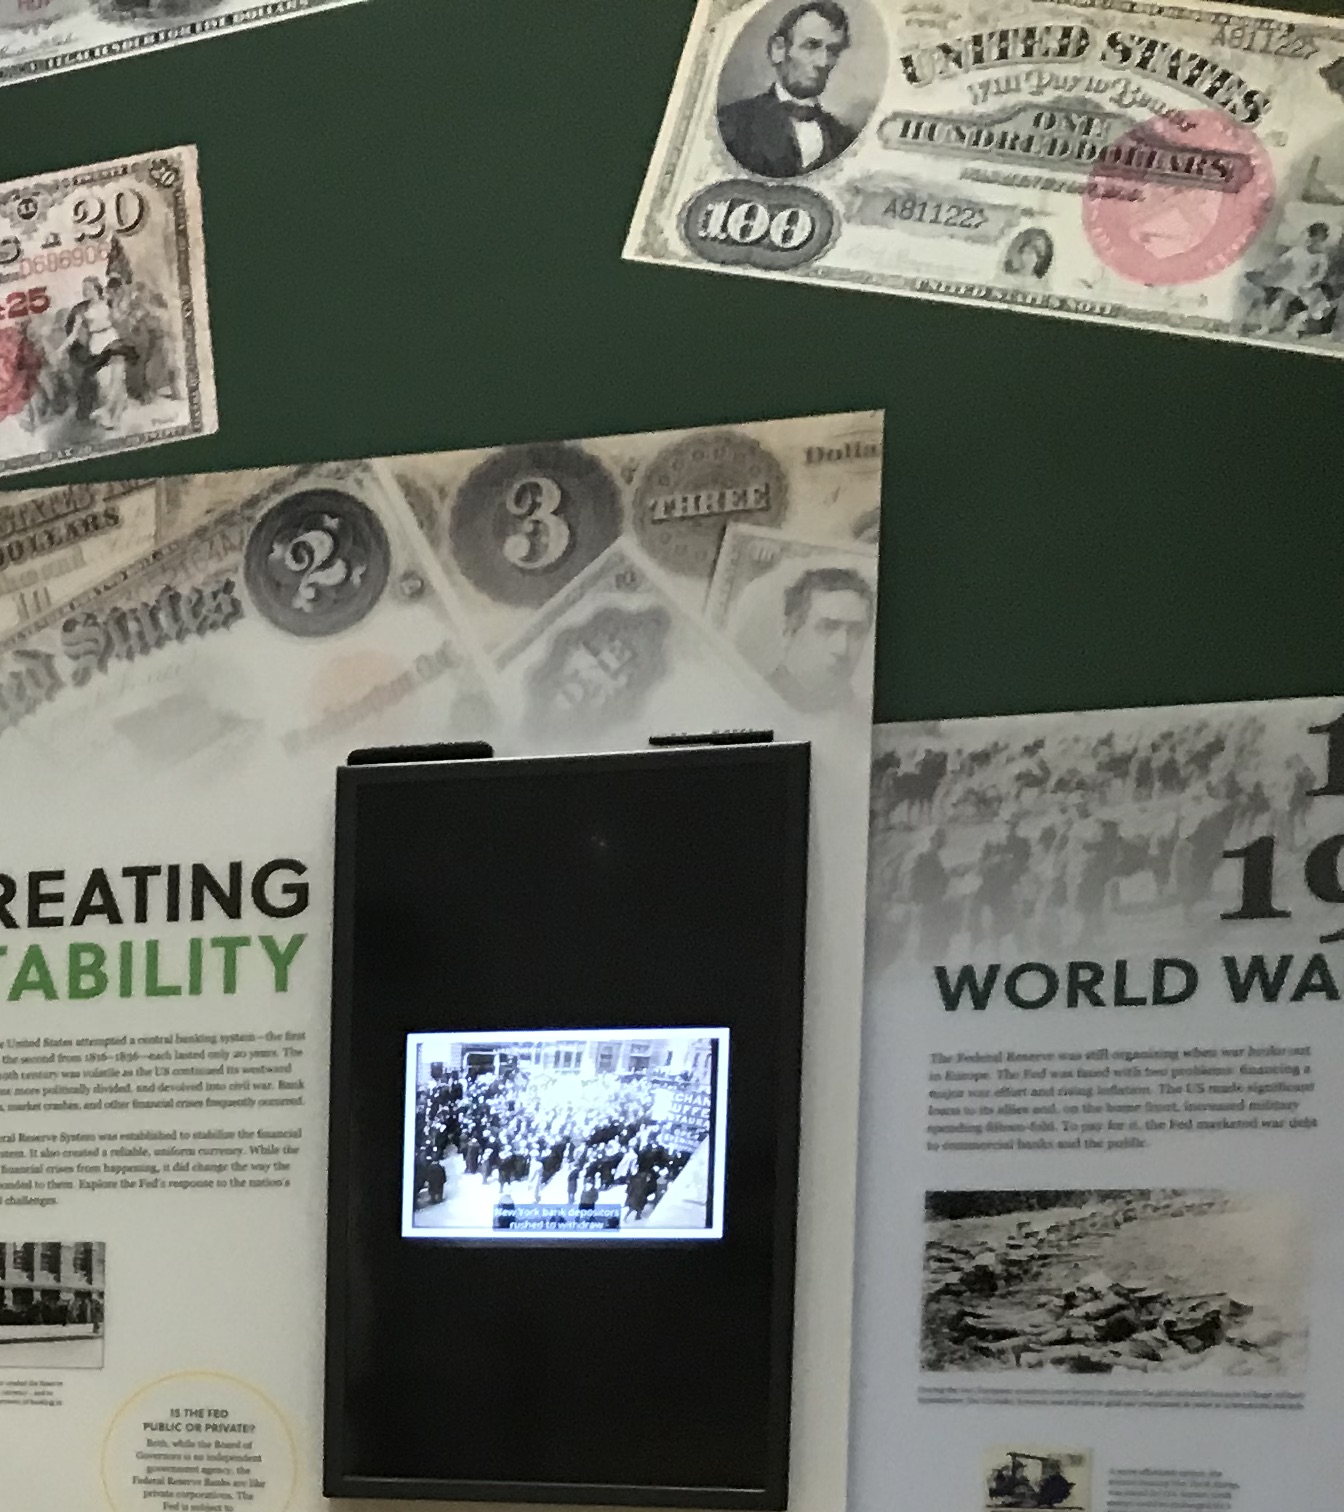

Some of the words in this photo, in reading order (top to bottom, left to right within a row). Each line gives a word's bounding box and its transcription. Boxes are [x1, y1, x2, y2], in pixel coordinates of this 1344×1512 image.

[900, 24, 1090, 88] UNITED
[1099, 29, 1273, 126] STATES
[72, 187, 150, 243] 20
[698, 199, 813, 251] 100
[502, 476, 572, 570] 3
[648, 484, 772, 524] THREE
[284, 529, 348, 613] 2
[62, 576, 245, 687] States
[934, 957, 1199, 1012] WORLD
[143, 1422, 182, 1432] PUBLIC
[185, 1422, 202, 1433] OR
[205, 1423, 256, 1434] PRIVATE?
[170, 1408, 181, 1418] IS
[183, 1408, 205, 1419] THE
[207, 1408, 229, 1419] FED
